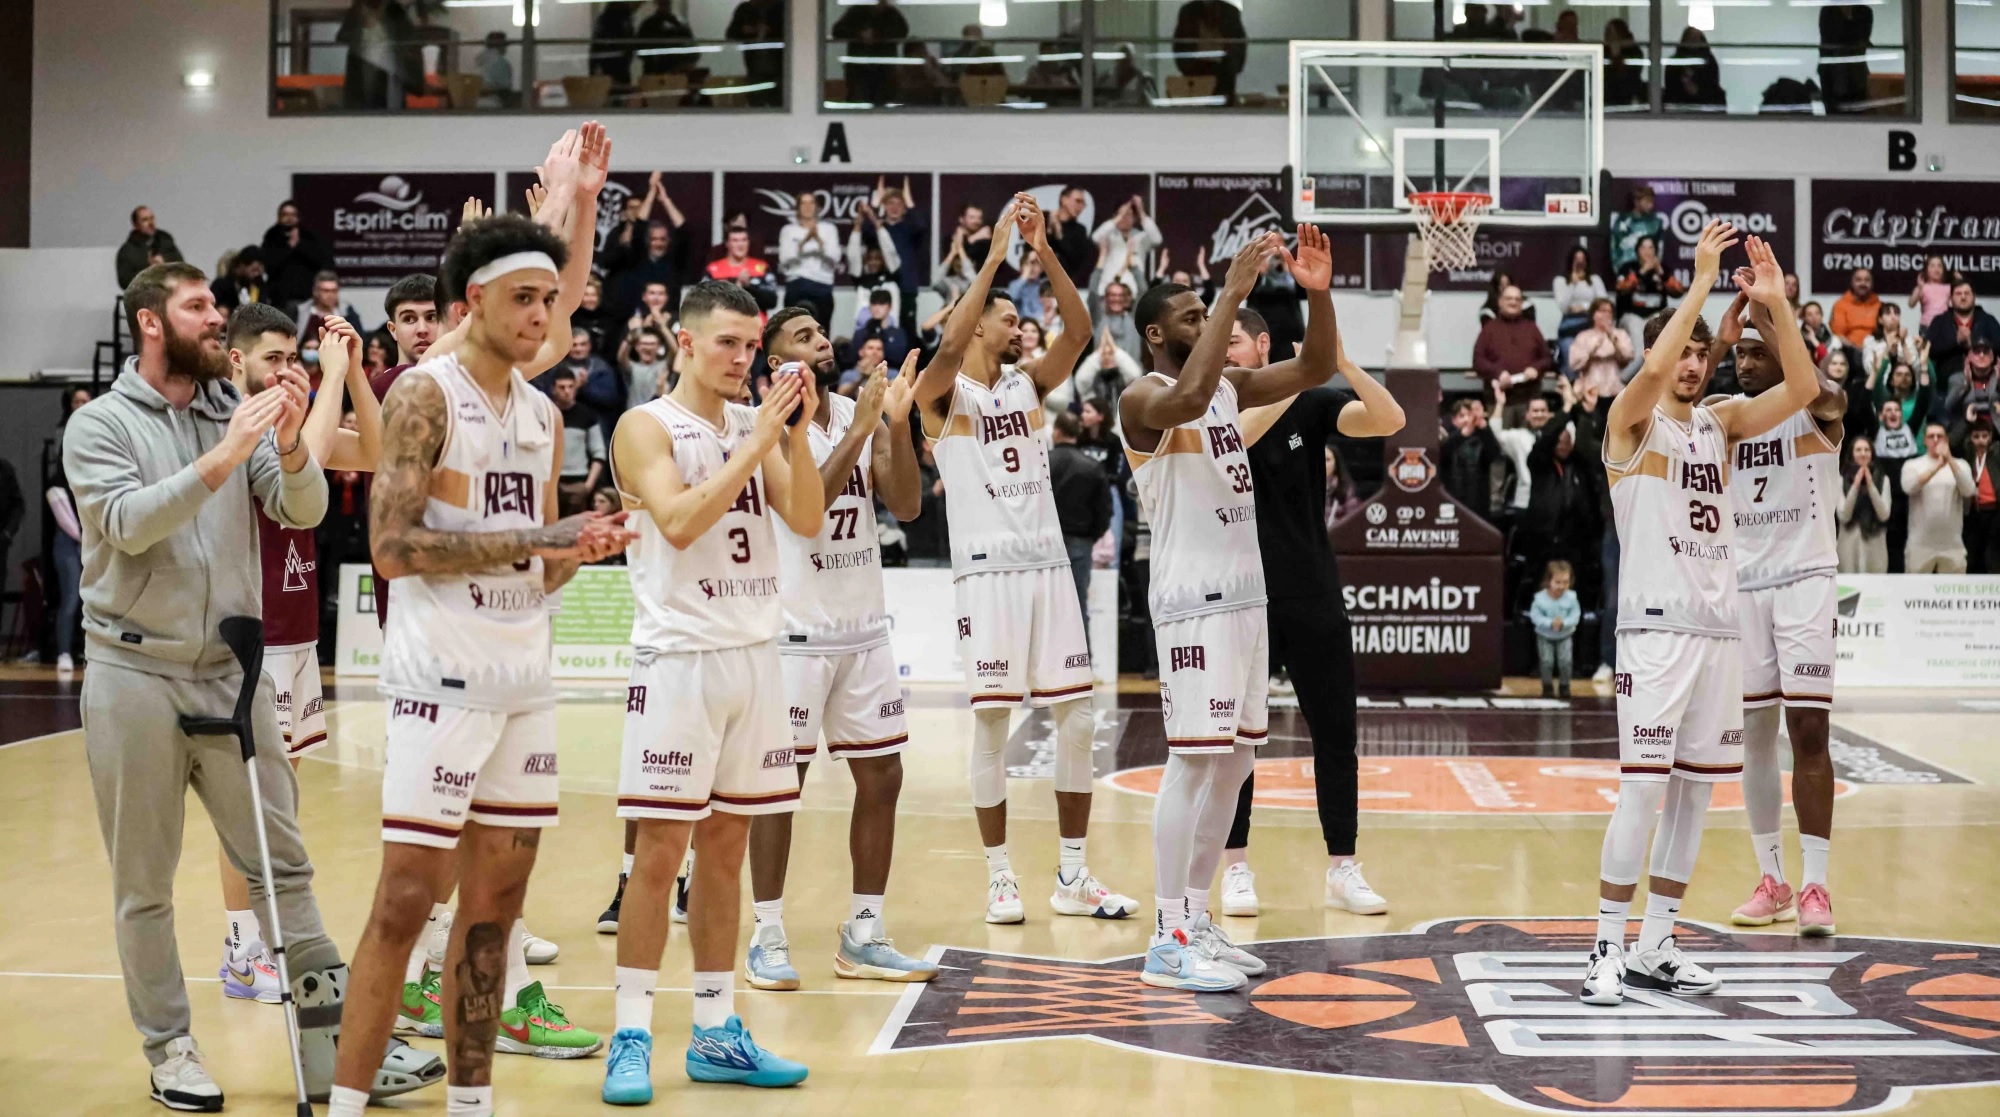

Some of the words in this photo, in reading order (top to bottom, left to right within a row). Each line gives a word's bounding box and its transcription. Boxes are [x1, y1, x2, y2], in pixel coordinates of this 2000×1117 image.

[820, 122, 851, 163] A
[1888, 130, 1917, 171] B
[1159, 176, 1189, 188] tous
[1193, 177, 1272, 191] marquages
[1691, 181, 1737, 195] TECHNIQUE
[333, 205, 449, 234] Esprit-clim
[1823, 254, 1873, 270] 67240
[982, 411, 1029, 445] ASA
[1002, 447, 1020, 473] 9
[1738, 438, 1785, 471] ASA
[1226, 463, 1253, 494] 32
[1753, 476, 1768, 503] 7
[484, 471, 535, 522] ASA
[829, 507, 859, 541] 77
[1689, 500, 1720, 533] 20
[1740, 508, 1801, 526] DECOPEINT
[728, 527, 751, 564] 3
[1366, 528, 1399, 543] CAR
[1401, 529, 1460, 543] AVENUE
[1934, 584, 1970, 595] VOTRE
[1904, 599, 1954, 610] VITRAGE
[1957, 599, 1969, 610] ET
[1351, 625, 1470, 654] HAGUENAU
[353, 649, 380, 666] les
[558, 655, 607, 667] vous
[1170, 645, 1206, 673] ASA
[641, 766, 691, 776] WEYERSHEIM
[642, 749, 693, 767] Souffel
[649, 784, 674, 792] CRAFT
[232, 921, 240, 942] CRAFT
